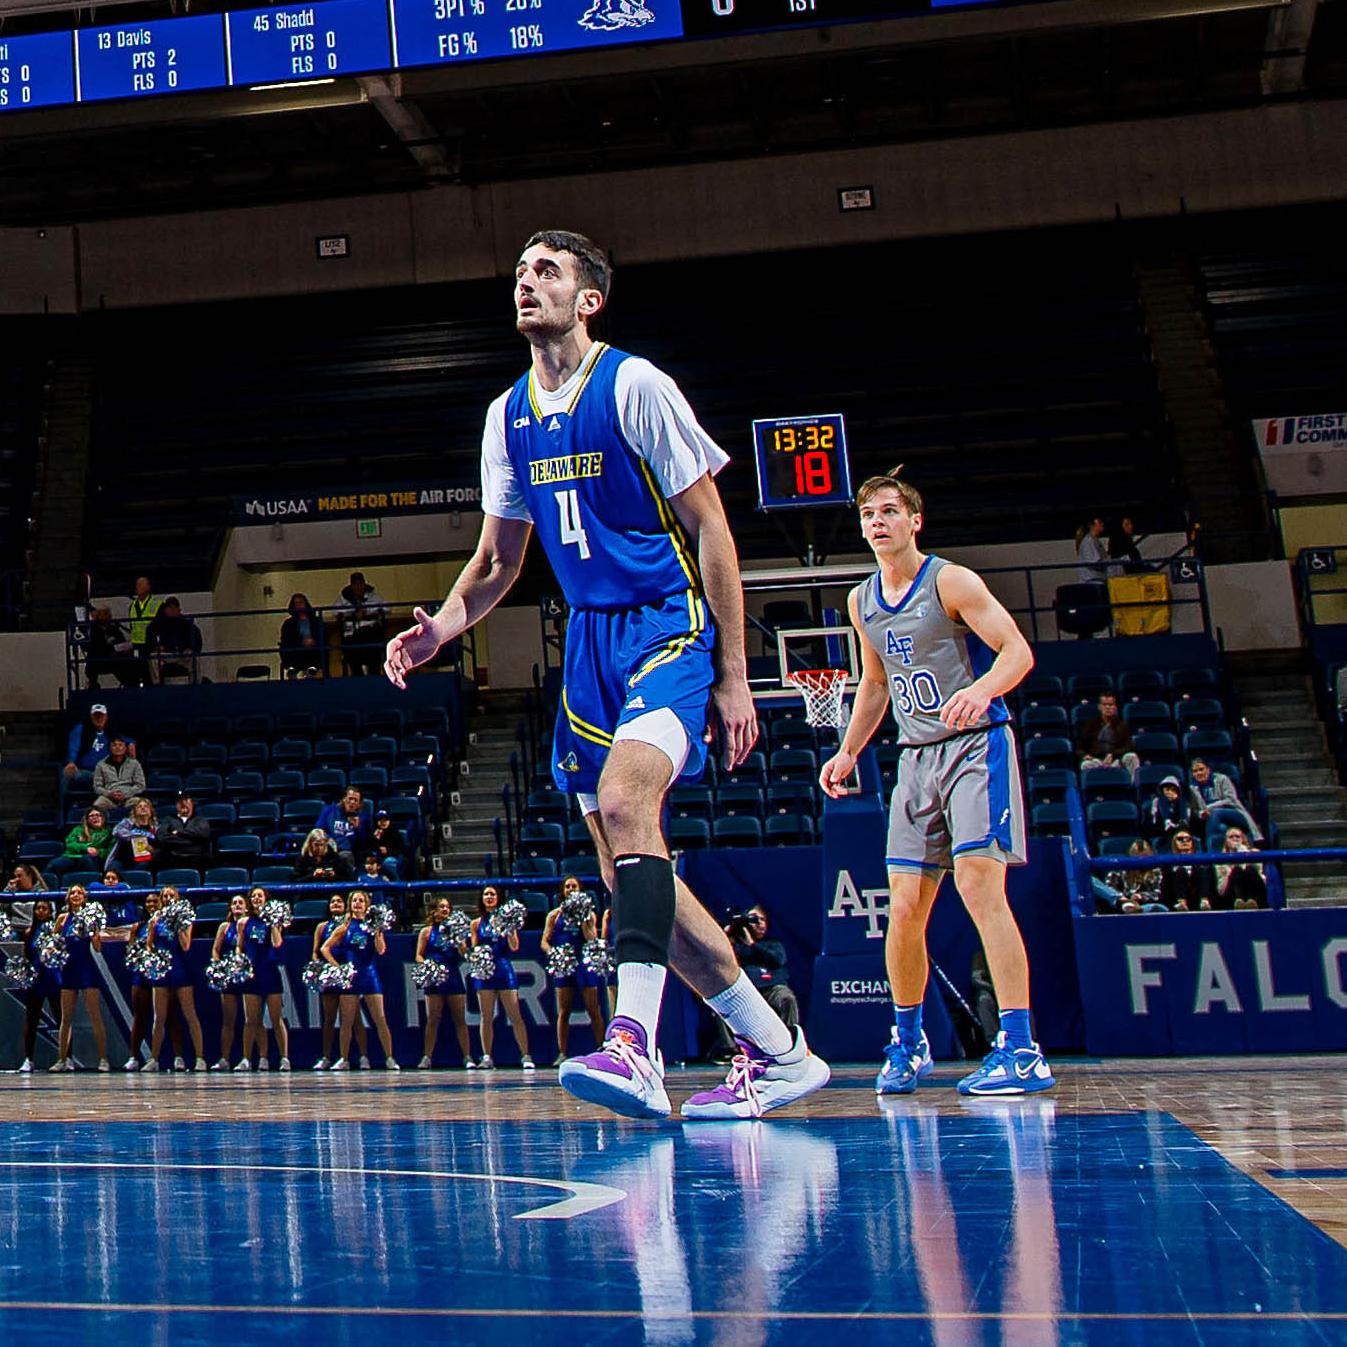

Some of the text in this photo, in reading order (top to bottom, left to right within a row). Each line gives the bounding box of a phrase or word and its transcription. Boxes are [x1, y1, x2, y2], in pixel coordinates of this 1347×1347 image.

[253, 9, 314, 31] 45 Shadd
[98, 29, 151, 50] 13 Davis
[291, 31, 335, 52] PTS 0
[438, 25, 543, 57] FG % 18%
[132, 49, 176, 70] PTS 2
[292, 53, 337, 73] FLS 0
[21, 64, 29, 81] 0
[134, 71, 177, 91] FLS 0
[22, 86, 30, 103] 0
[1298, 414, 1344, 430] FIRST
[774, 425, 834, 452] 13:32
[529, 452, 603, 485] DELAWARE
[795, 451, 832, 495] 18
[267, 486, 483, 516] USAA MADE FOR THE AIR FORC
[554, 490, 591, 560] 4
[885, 628, 913, 664] AF
[890, 671, 940, 714] 30
[831, 980, 891, 994] EXCHAN
